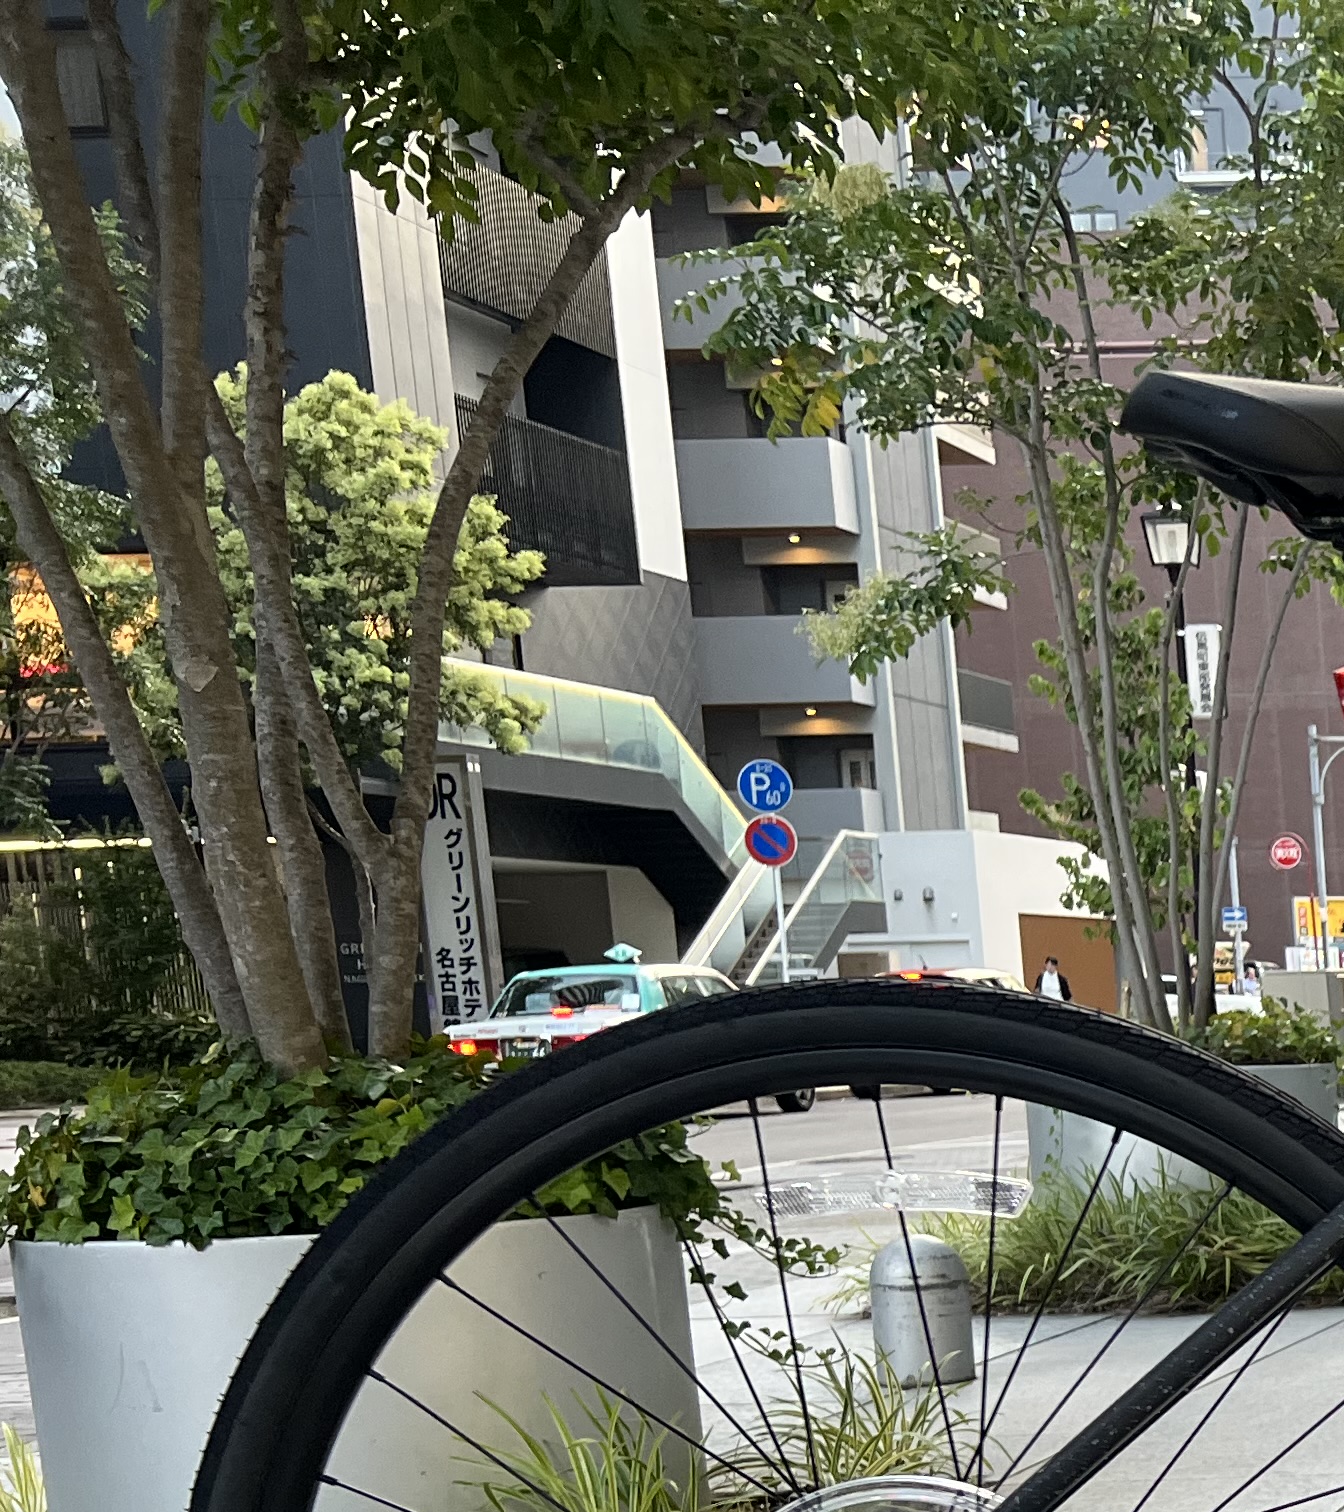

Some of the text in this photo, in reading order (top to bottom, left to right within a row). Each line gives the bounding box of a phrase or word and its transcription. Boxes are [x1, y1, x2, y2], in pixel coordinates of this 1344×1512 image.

[444, 828, 482, 1023] グリーンリッチホテ
